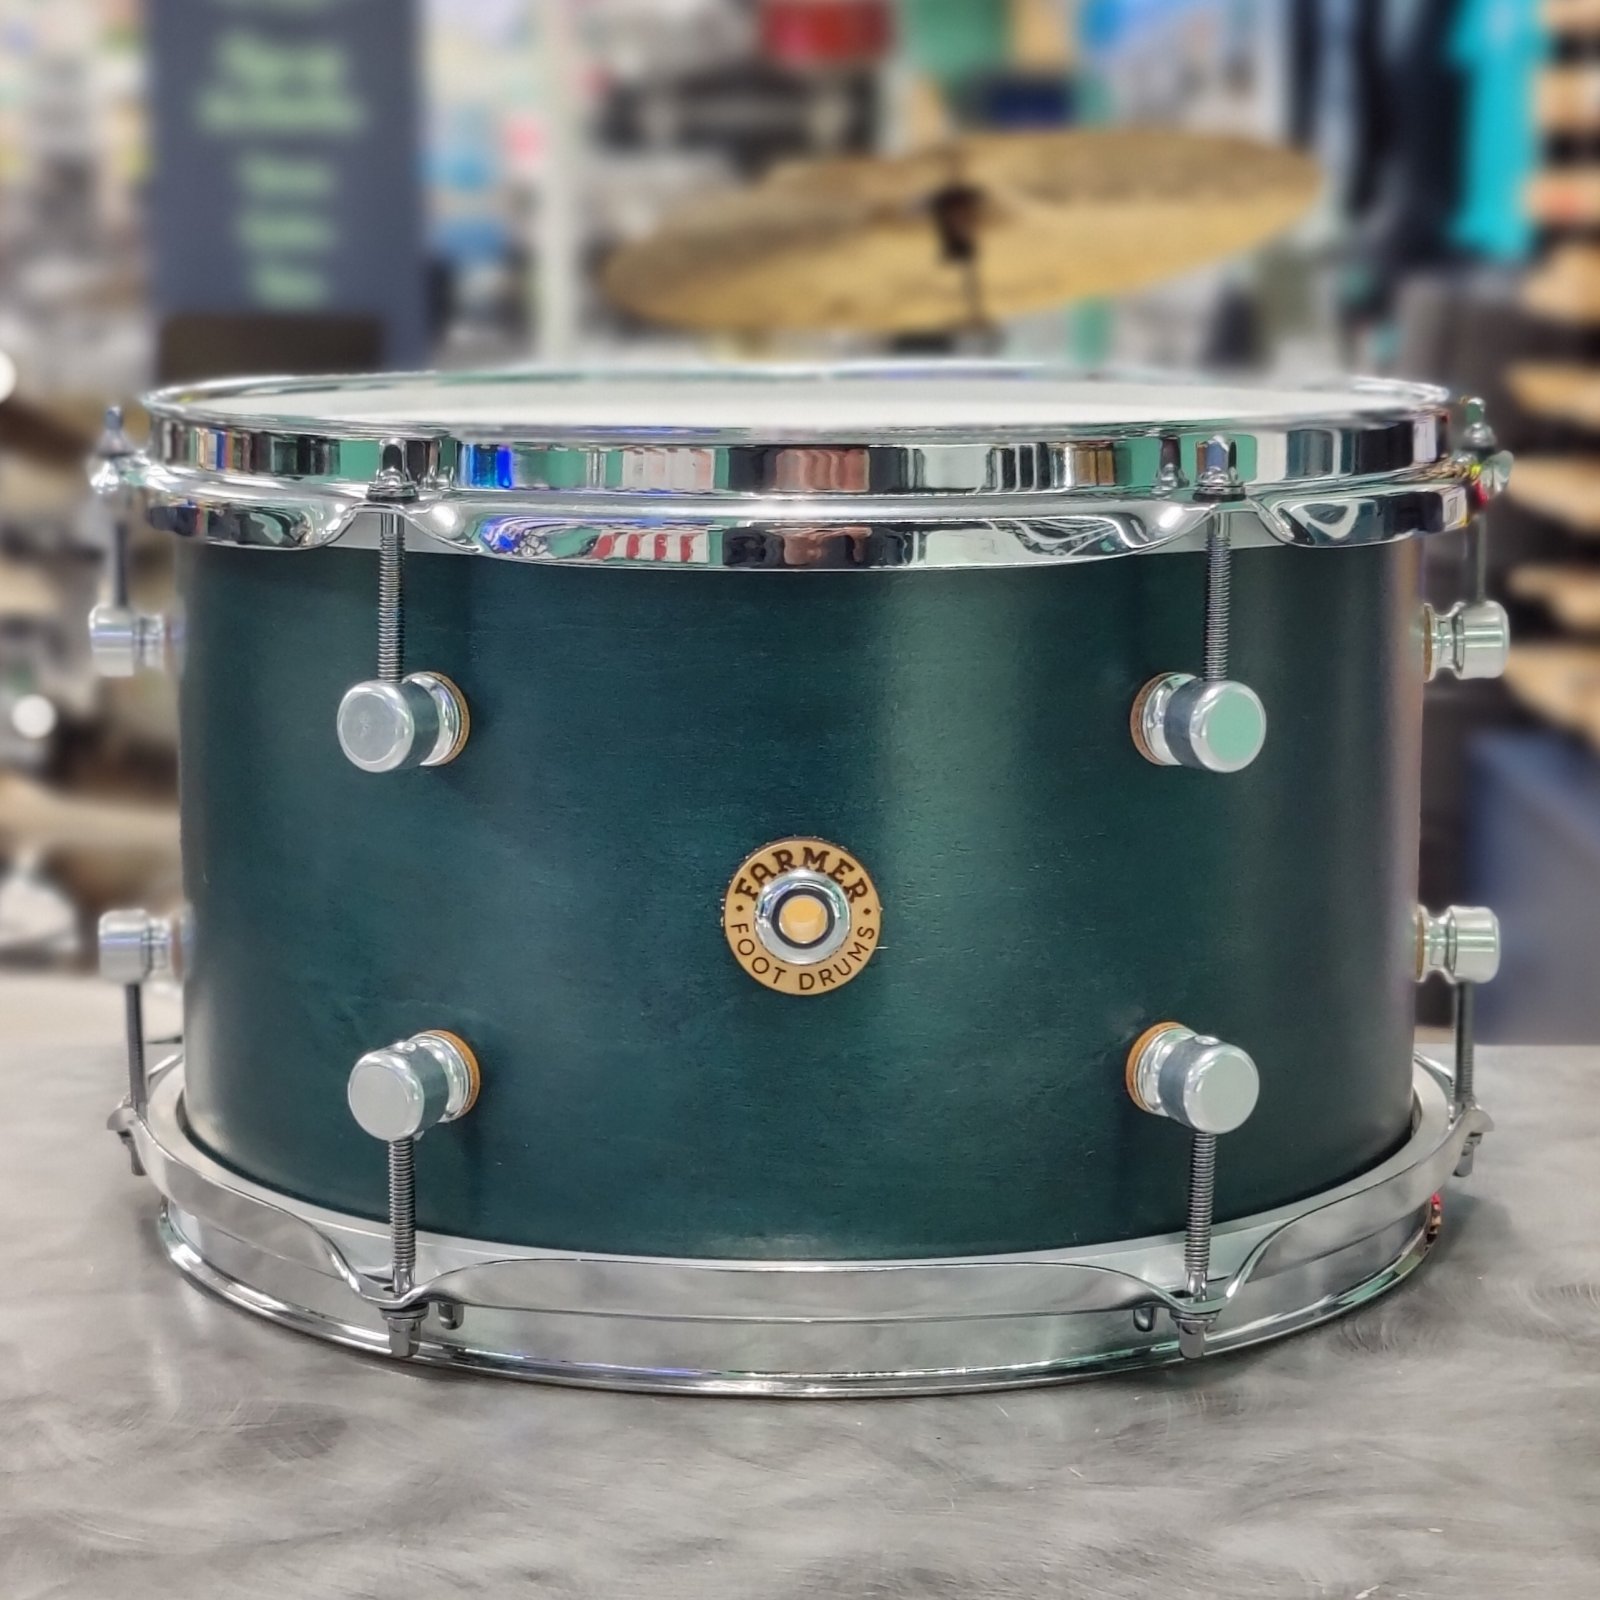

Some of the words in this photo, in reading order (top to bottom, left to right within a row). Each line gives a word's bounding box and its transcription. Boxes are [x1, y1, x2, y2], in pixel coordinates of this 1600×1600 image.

[735, 847, 868, 904] FARMER
[731, 923, 787, 984] FOOT
[799, 926, 875, 990] DRUMS
